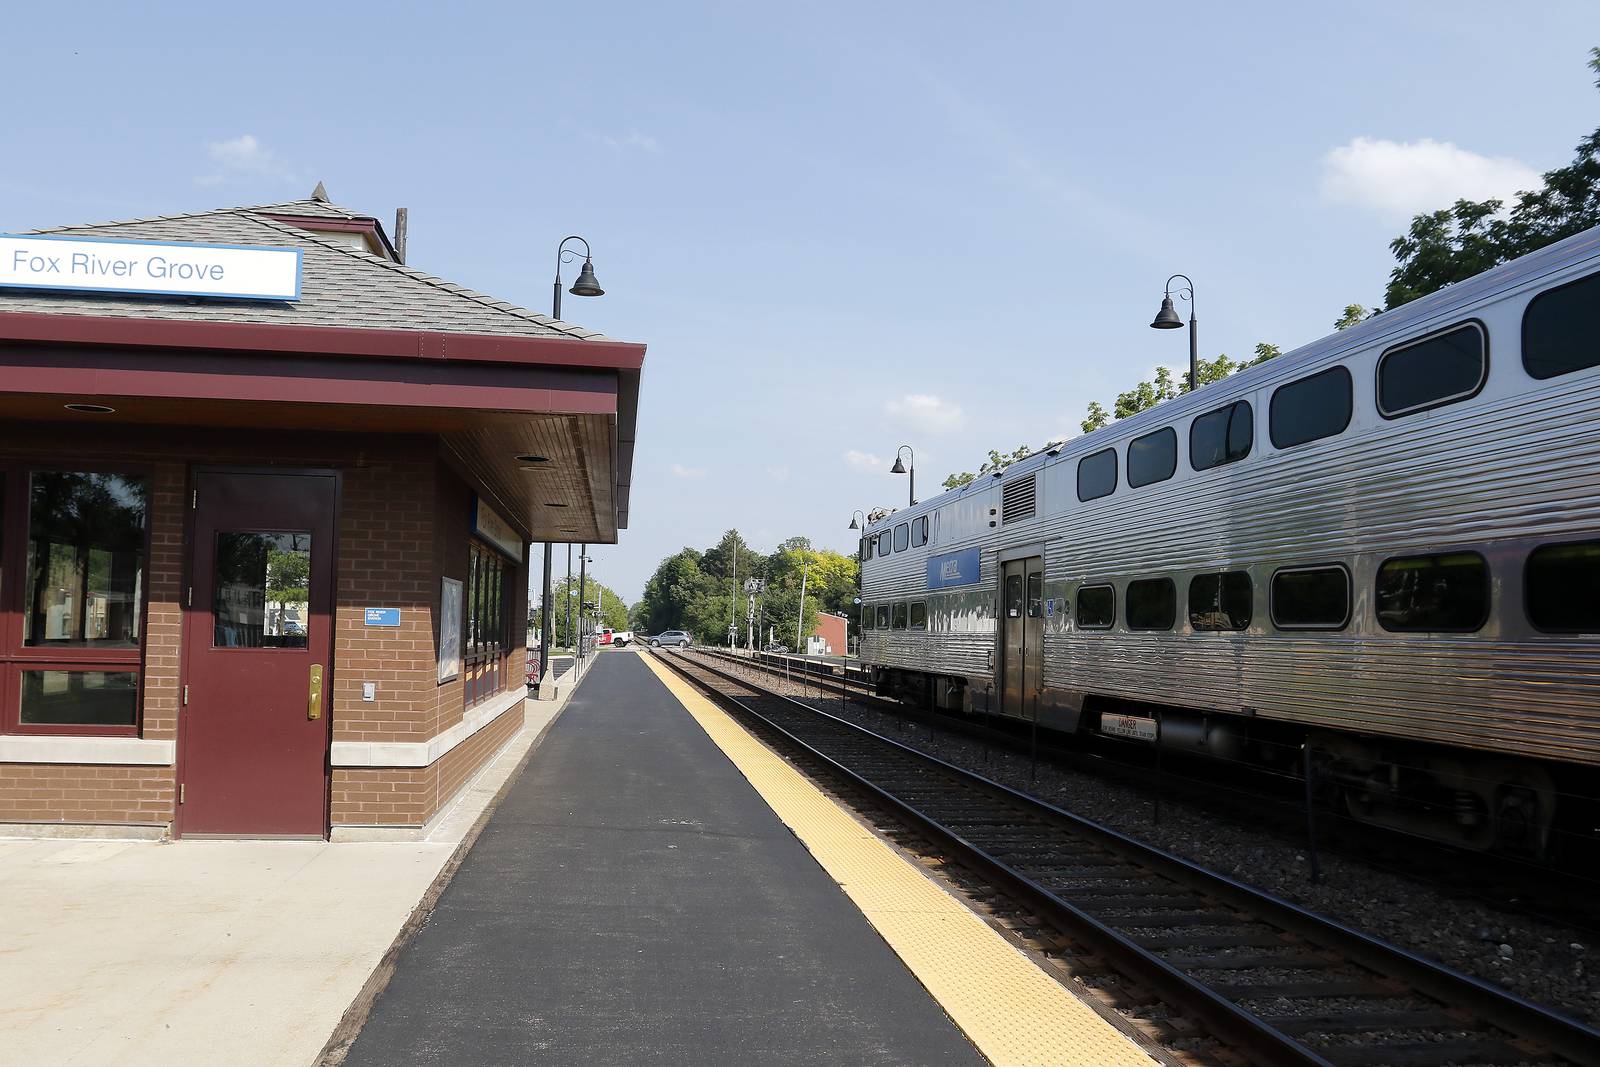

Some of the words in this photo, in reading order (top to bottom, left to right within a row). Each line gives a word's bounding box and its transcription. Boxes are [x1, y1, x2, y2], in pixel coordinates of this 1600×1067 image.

[13, 250, 60, 273] Fox
[71, 252, 138, 277] River
[147, 256, 225, 281] Grove
[1118, 717, 1137, 729] DANGER
